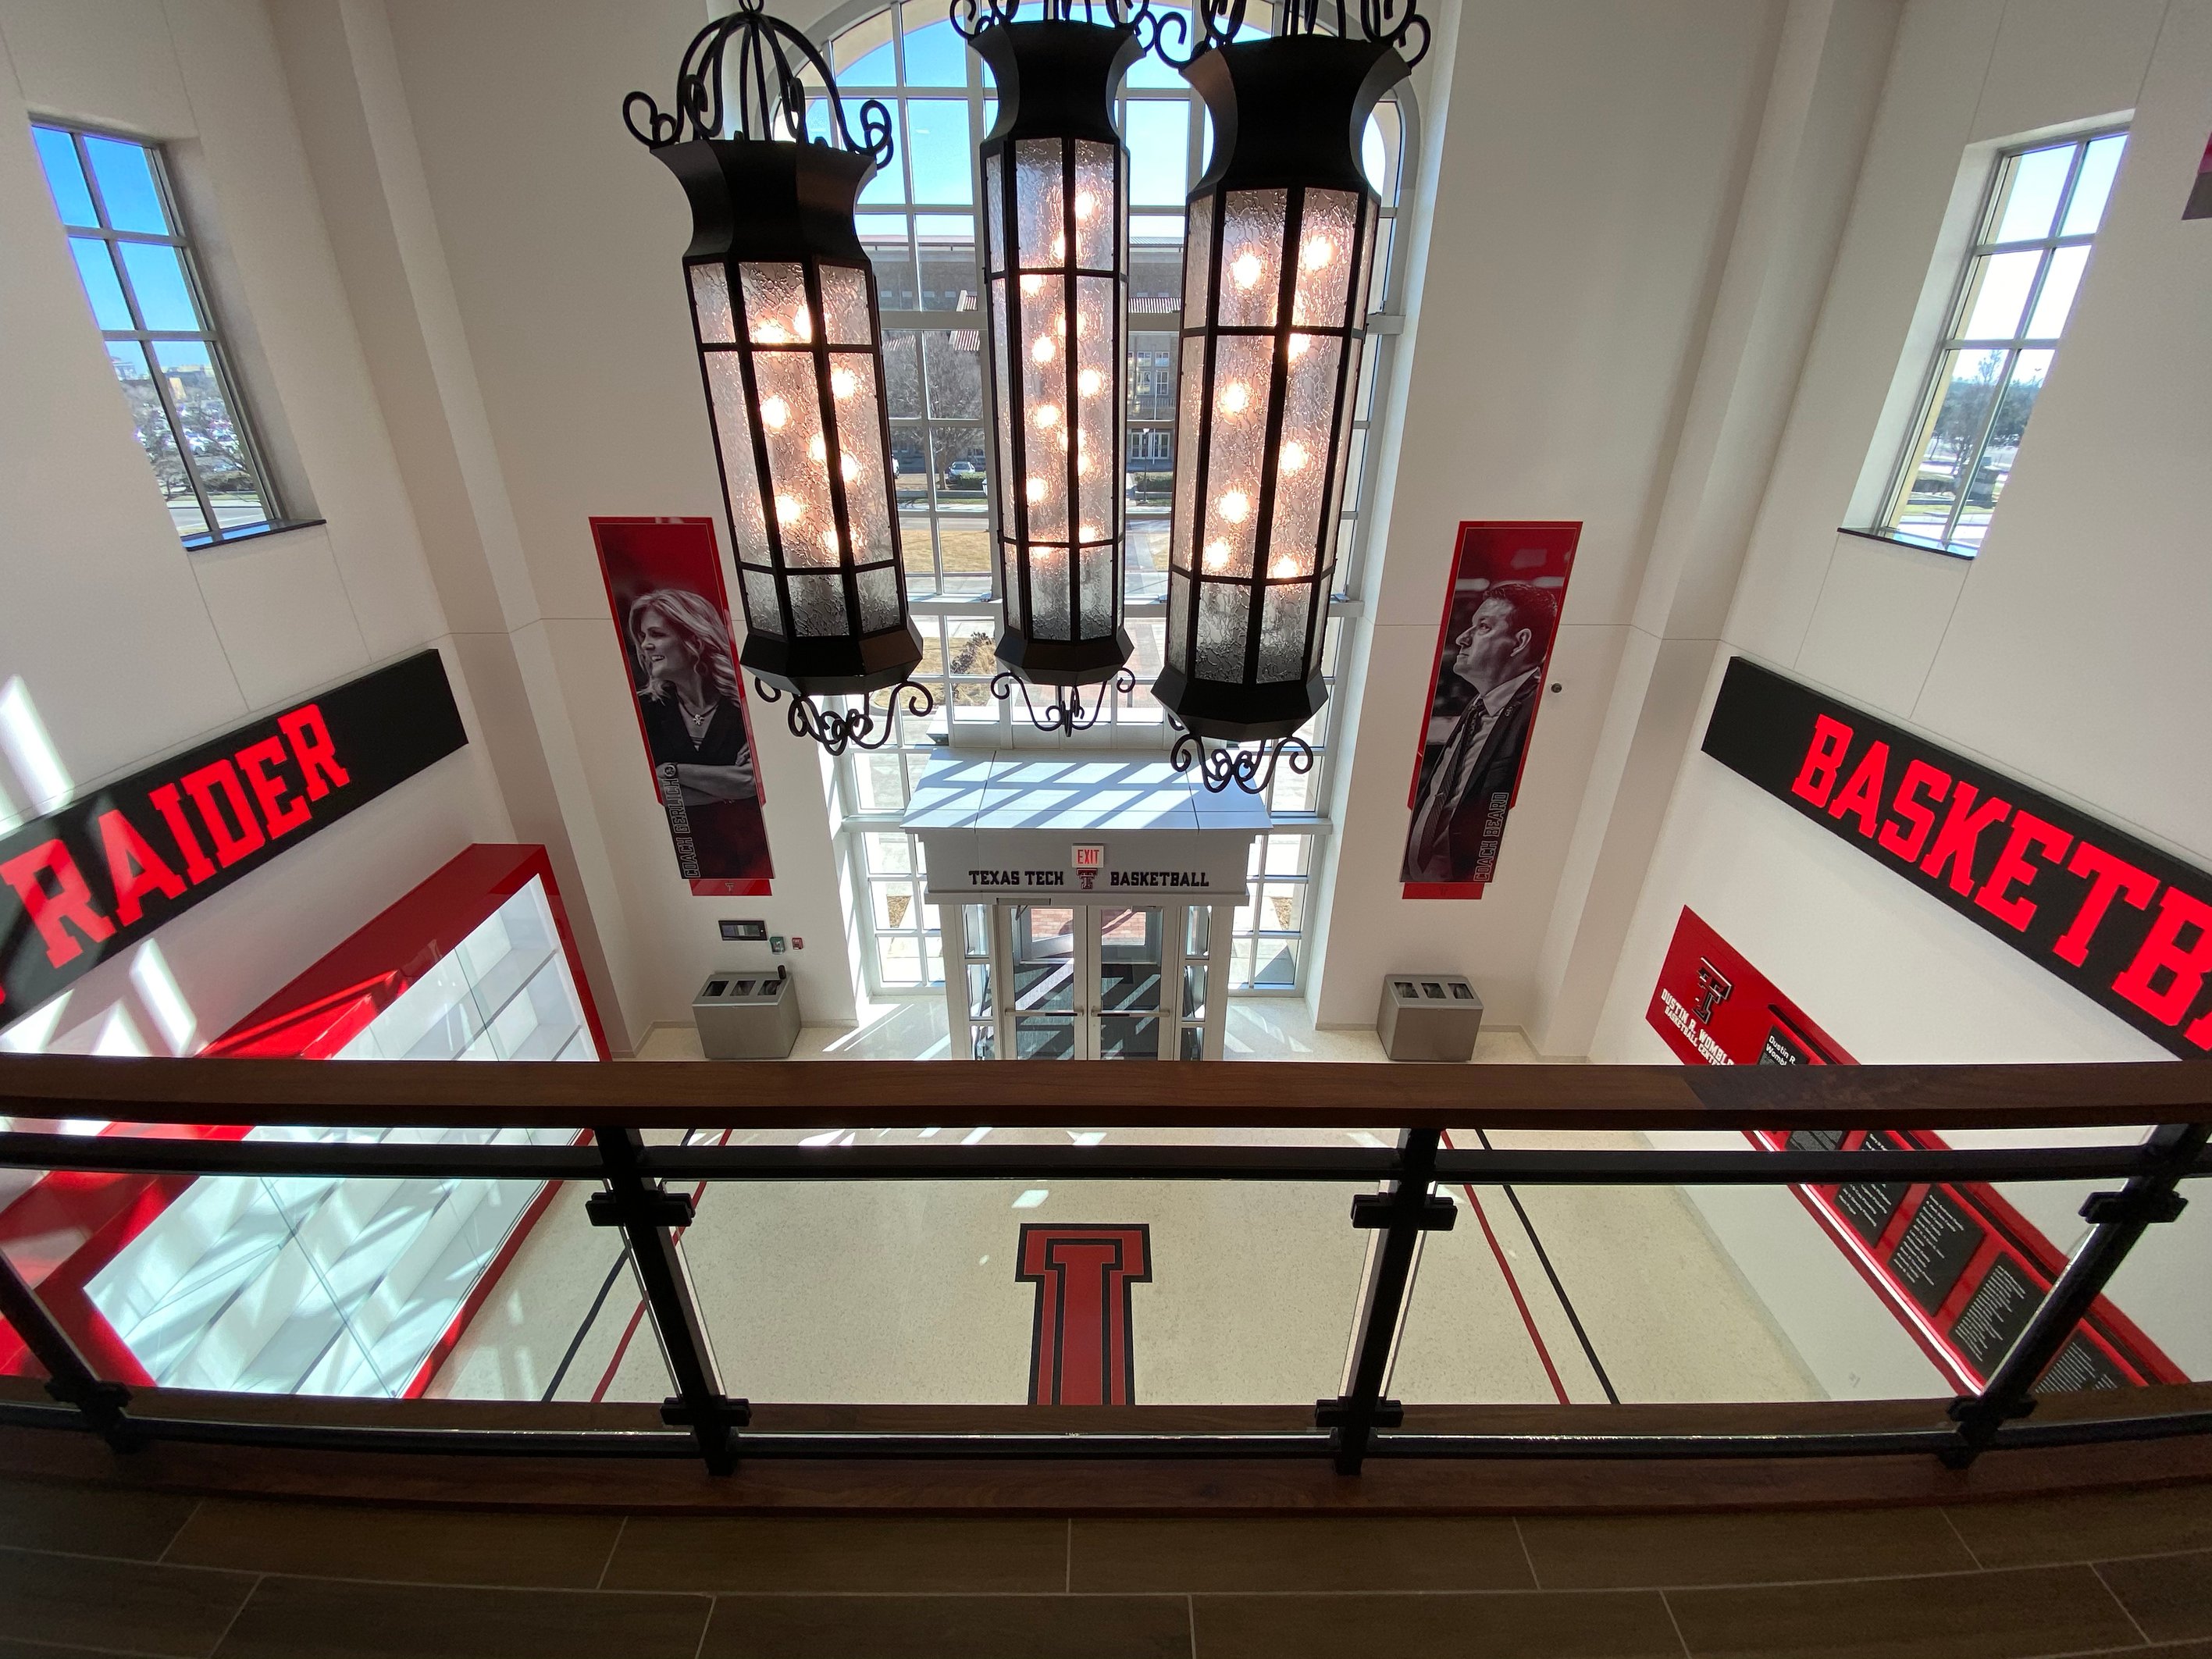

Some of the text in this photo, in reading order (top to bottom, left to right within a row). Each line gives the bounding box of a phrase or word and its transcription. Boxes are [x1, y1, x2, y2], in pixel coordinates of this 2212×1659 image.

[0, 703, 351, 968] RAIDER
[663, 778, 701, 878] COACH GERLICH
[1078, 849, 1100, 864] EXIT
[1473, 792, 1509, 881] COACH BEARD
[968, 870, 1020, 885] TEXAS
[1024, 870, 1064, 885] TECH
[1110, 871, 1209, 887] BASKETBALL
[1792, 714, 2212, 1051] BASKETB
[1661, 988, 1690, 1024] DUSTIN
[1664, 1006, 1721, 1065] BASKETBALL CENTE
[1769, 1035, 1789, 1059] Dustin
